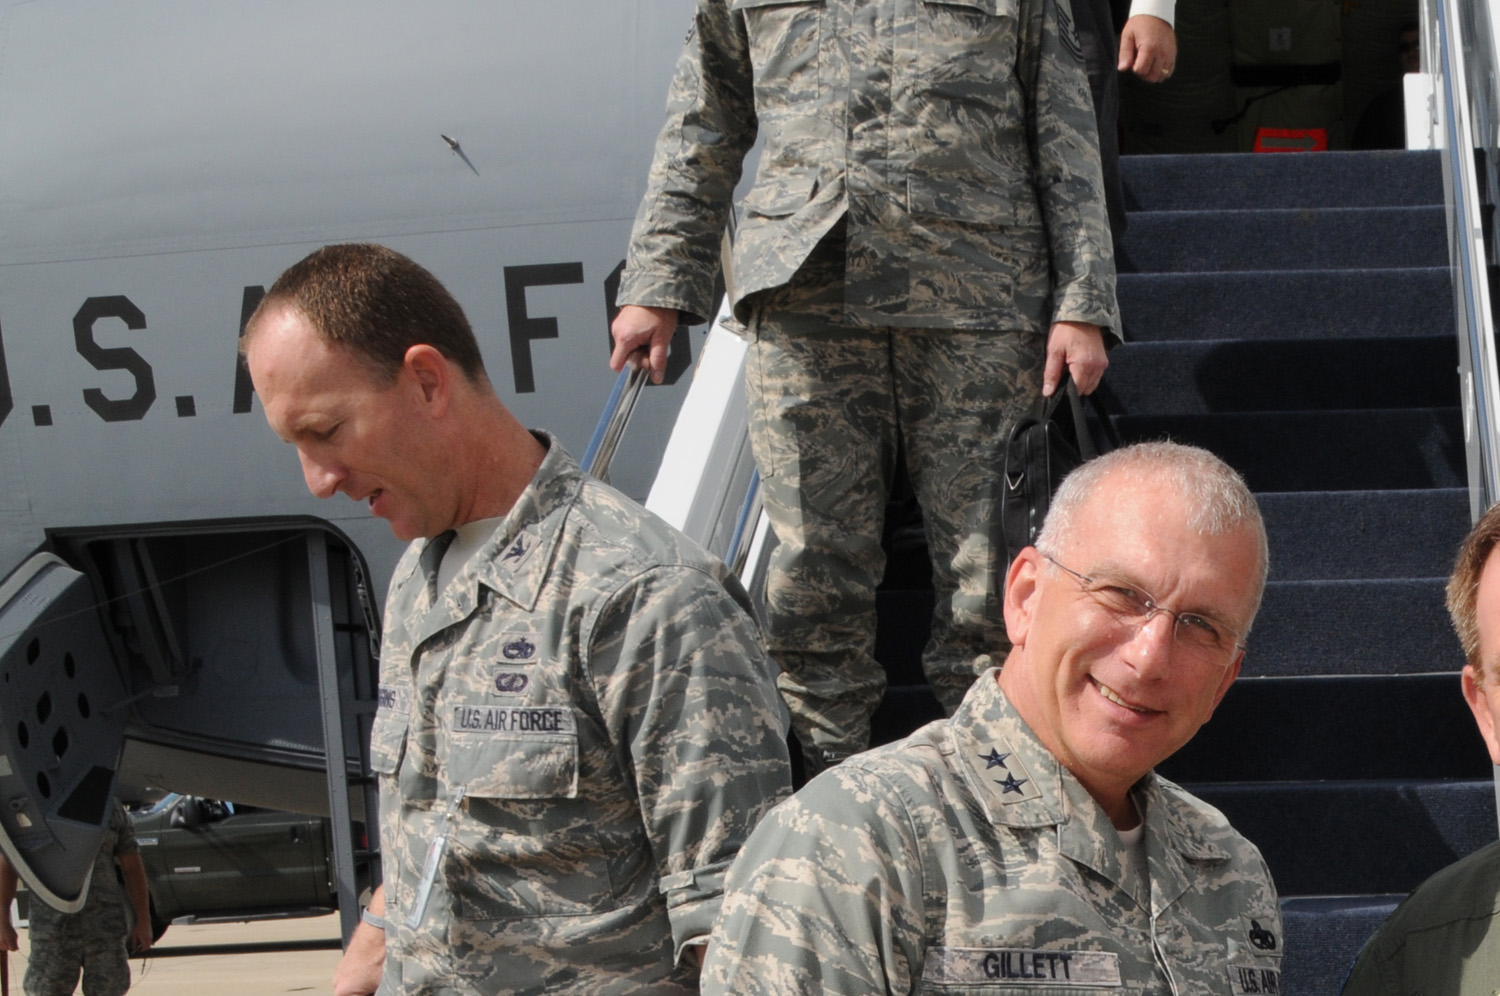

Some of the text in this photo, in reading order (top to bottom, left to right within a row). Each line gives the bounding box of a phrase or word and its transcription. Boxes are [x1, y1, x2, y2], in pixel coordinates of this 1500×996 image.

[461, 709, 564, 731] U.S. AIR FORCE
[984, 952, 1074, 979] GILLETT
[1238, 968, 1277, 995] U.S. AIR
